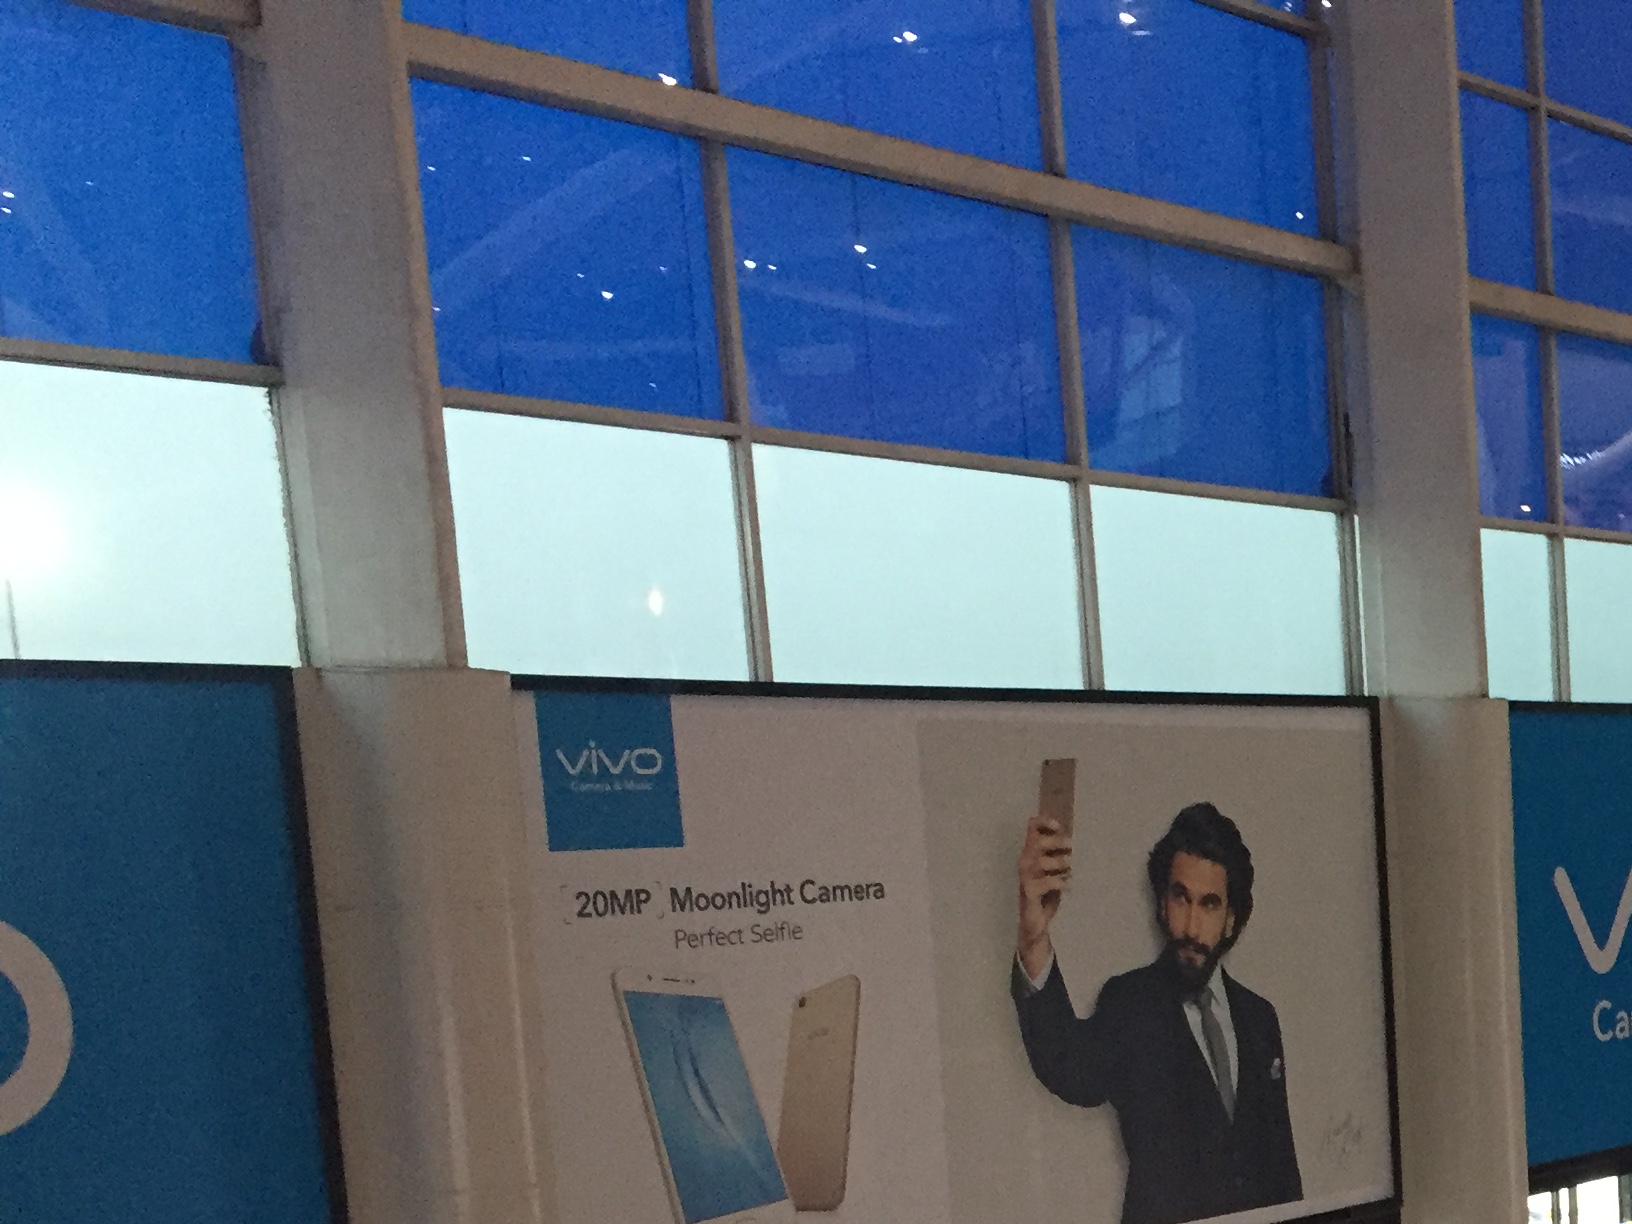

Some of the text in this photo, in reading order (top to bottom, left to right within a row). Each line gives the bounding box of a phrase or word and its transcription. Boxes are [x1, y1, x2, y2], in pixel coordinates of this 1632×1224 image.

[555, 740, 662, 775] vivo
[575, 878, 886, 918] 20MP Moonlight Camera
[674, 921, 804, 949] Perfect Selfie
